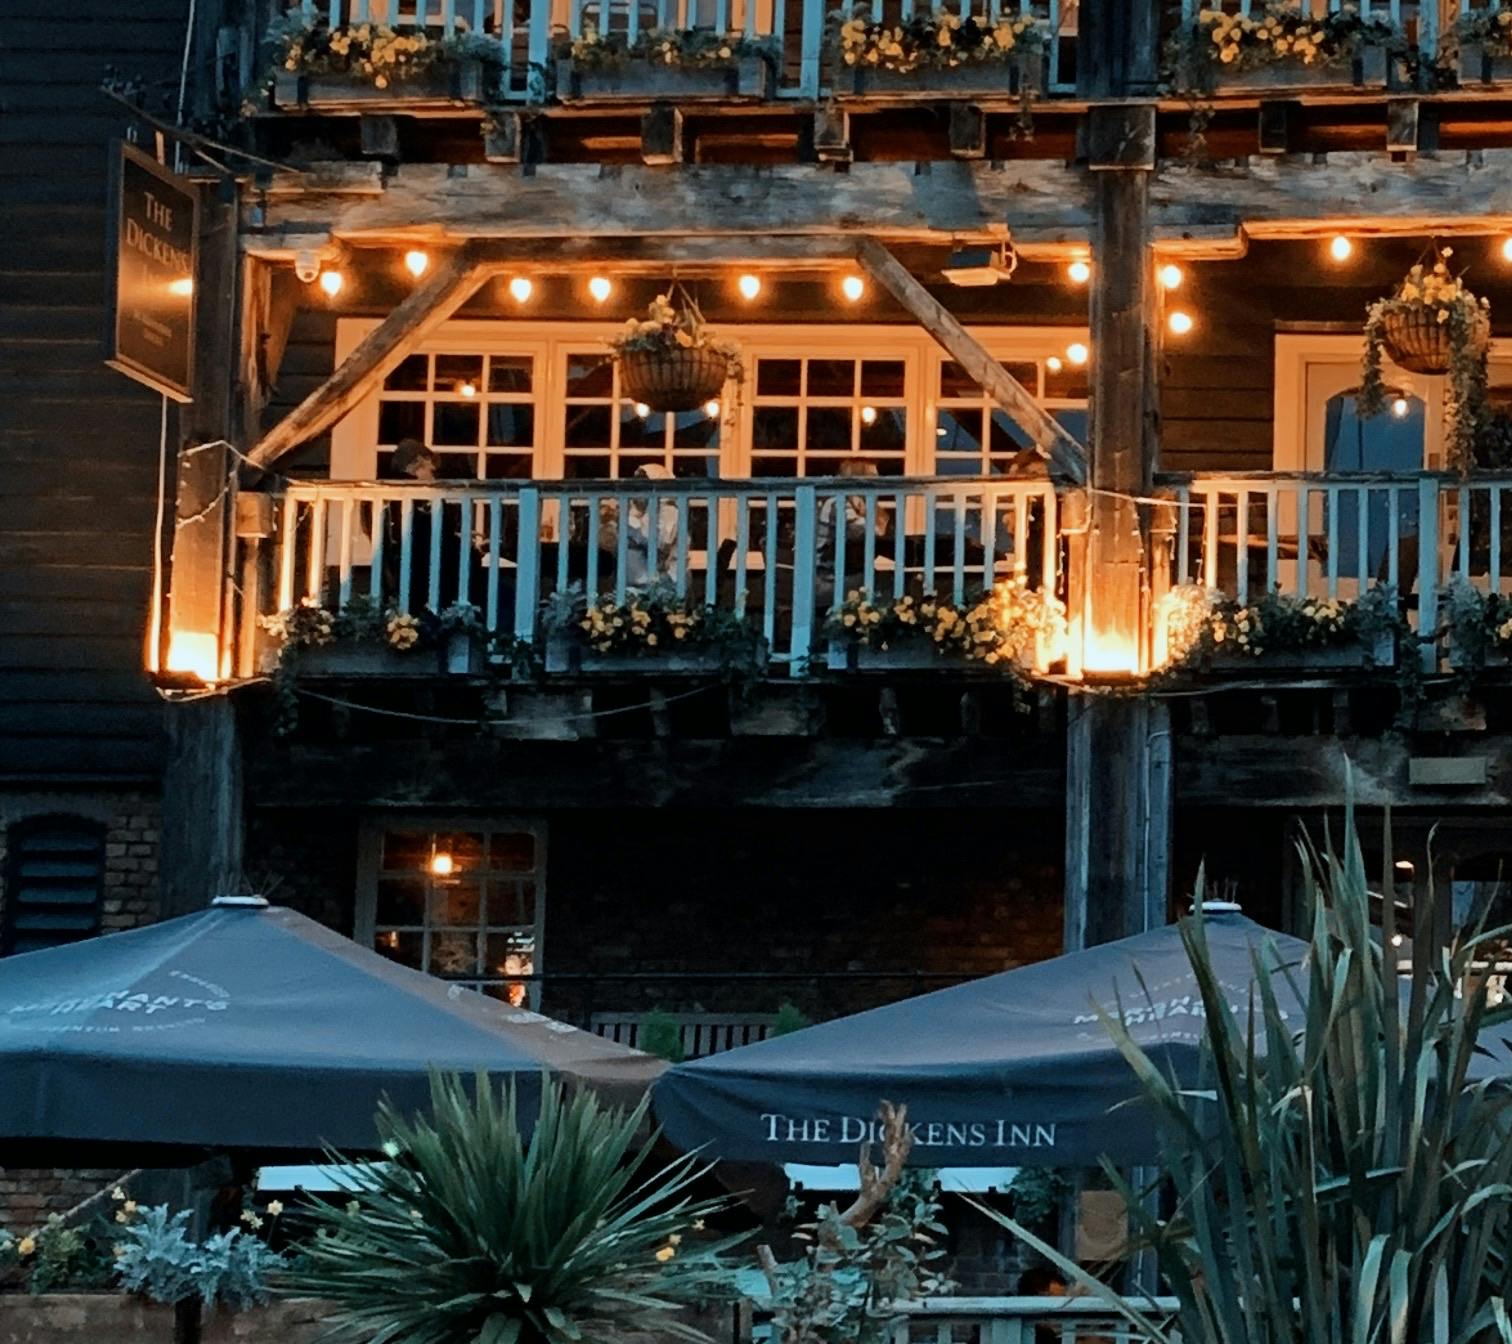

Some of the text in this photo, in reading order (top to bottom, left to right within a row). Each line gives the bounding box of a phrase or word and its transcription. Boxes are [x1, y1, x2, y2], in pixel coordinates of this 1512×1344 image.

[144, 191, 174, 232] THE
[760, 1113, 831, 1142] THE
[994, 1119, 1057, 1147] INN
